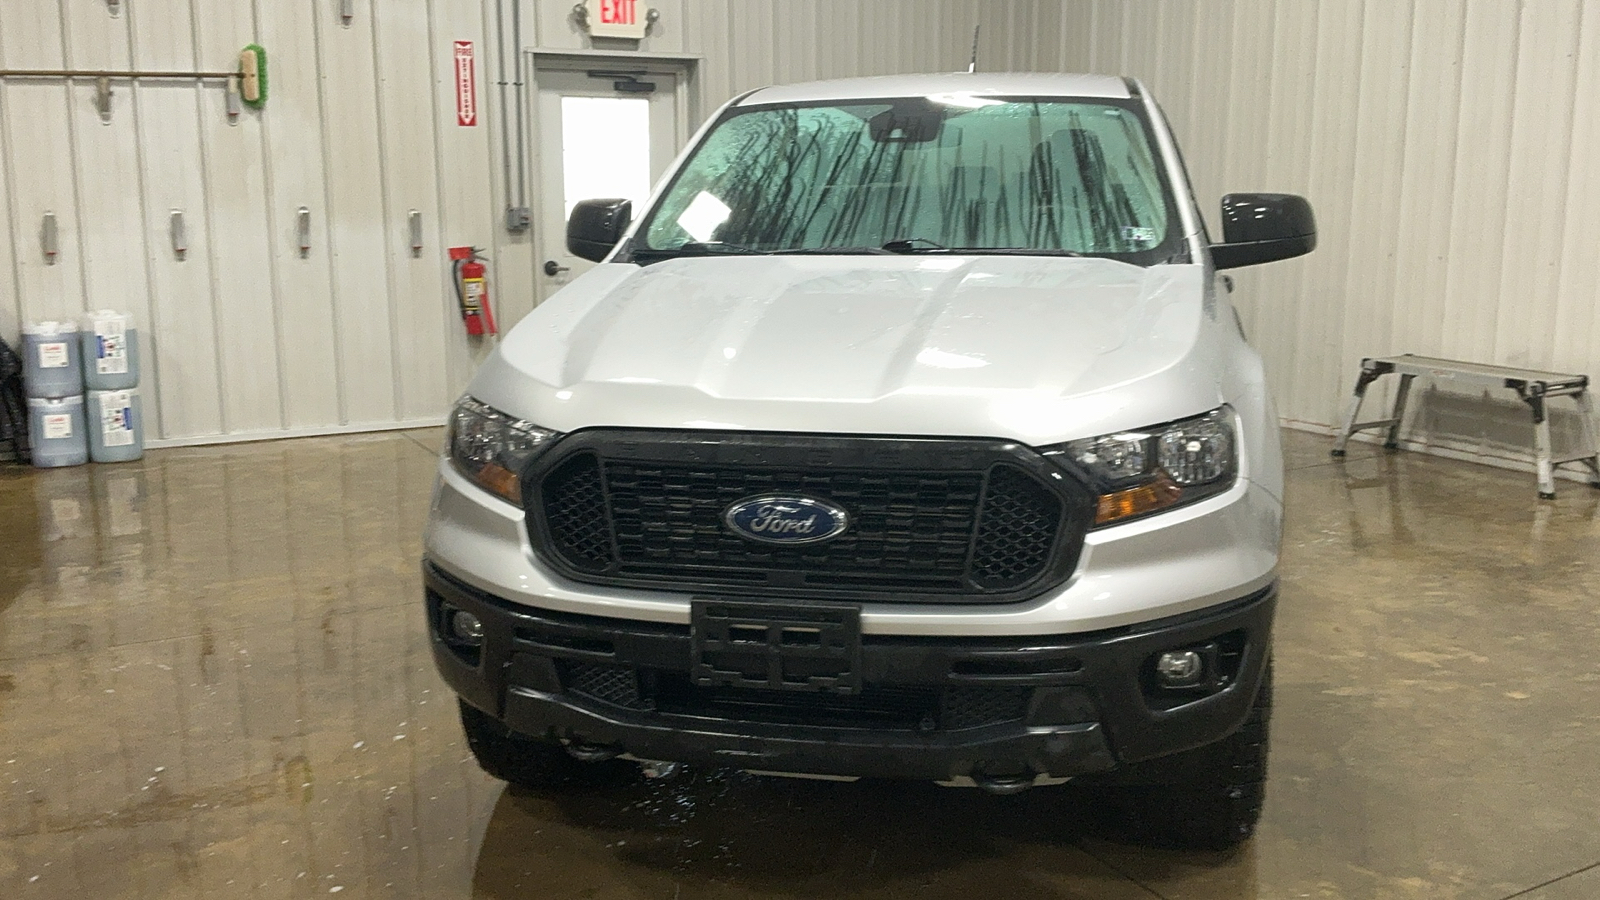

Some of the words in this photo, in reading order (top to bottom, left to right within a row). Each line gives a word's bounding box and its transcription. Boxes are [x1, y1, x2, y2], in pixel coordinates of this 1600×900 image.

[601, 0, 636, 25] EXIT
[455, 48, 472, 56] FIRE
[750, 504, 817, 533] Ford
